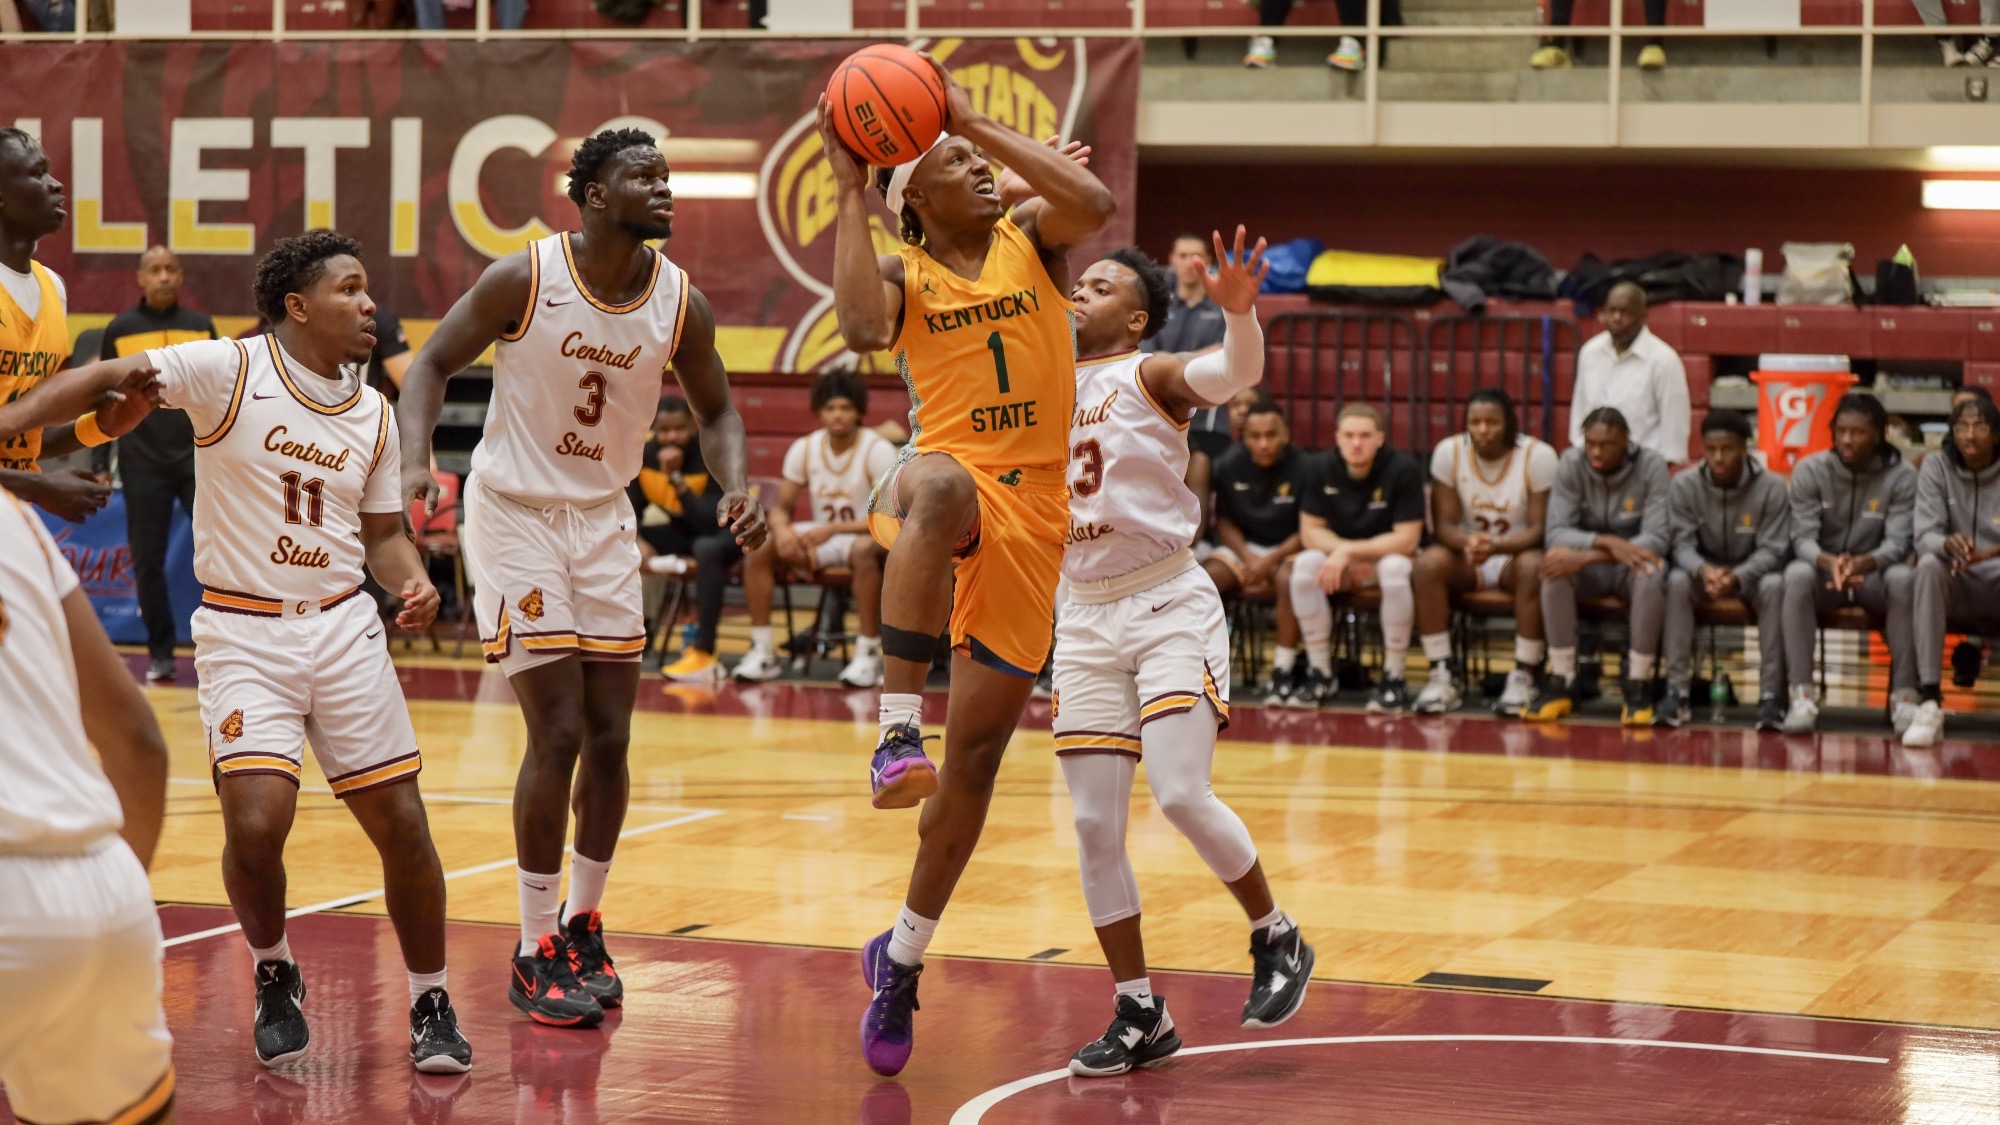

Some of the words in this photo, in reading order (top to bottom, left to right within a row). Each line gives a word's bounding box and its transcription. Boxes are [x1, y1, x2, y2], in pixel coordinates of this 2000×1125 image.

[14, 115, 672, 261] LETIC
[924, 286, 1039, 334] KENTUCKY
[0, 350, 61, 377] ENTUCKY
[560, 331, 642, 370] Central
[987, 331, 1010, 394] 1
[574, 371, 607, 427] 3
[971, 401, 1037, 432] STATE
[1780, 387, 1807, 419] G
[264, 425, 350, 472] Central
[1068, 437, 1105, 498] 3
[279, 470, 325, 527] 11
[270, 535, 330, 569] State
